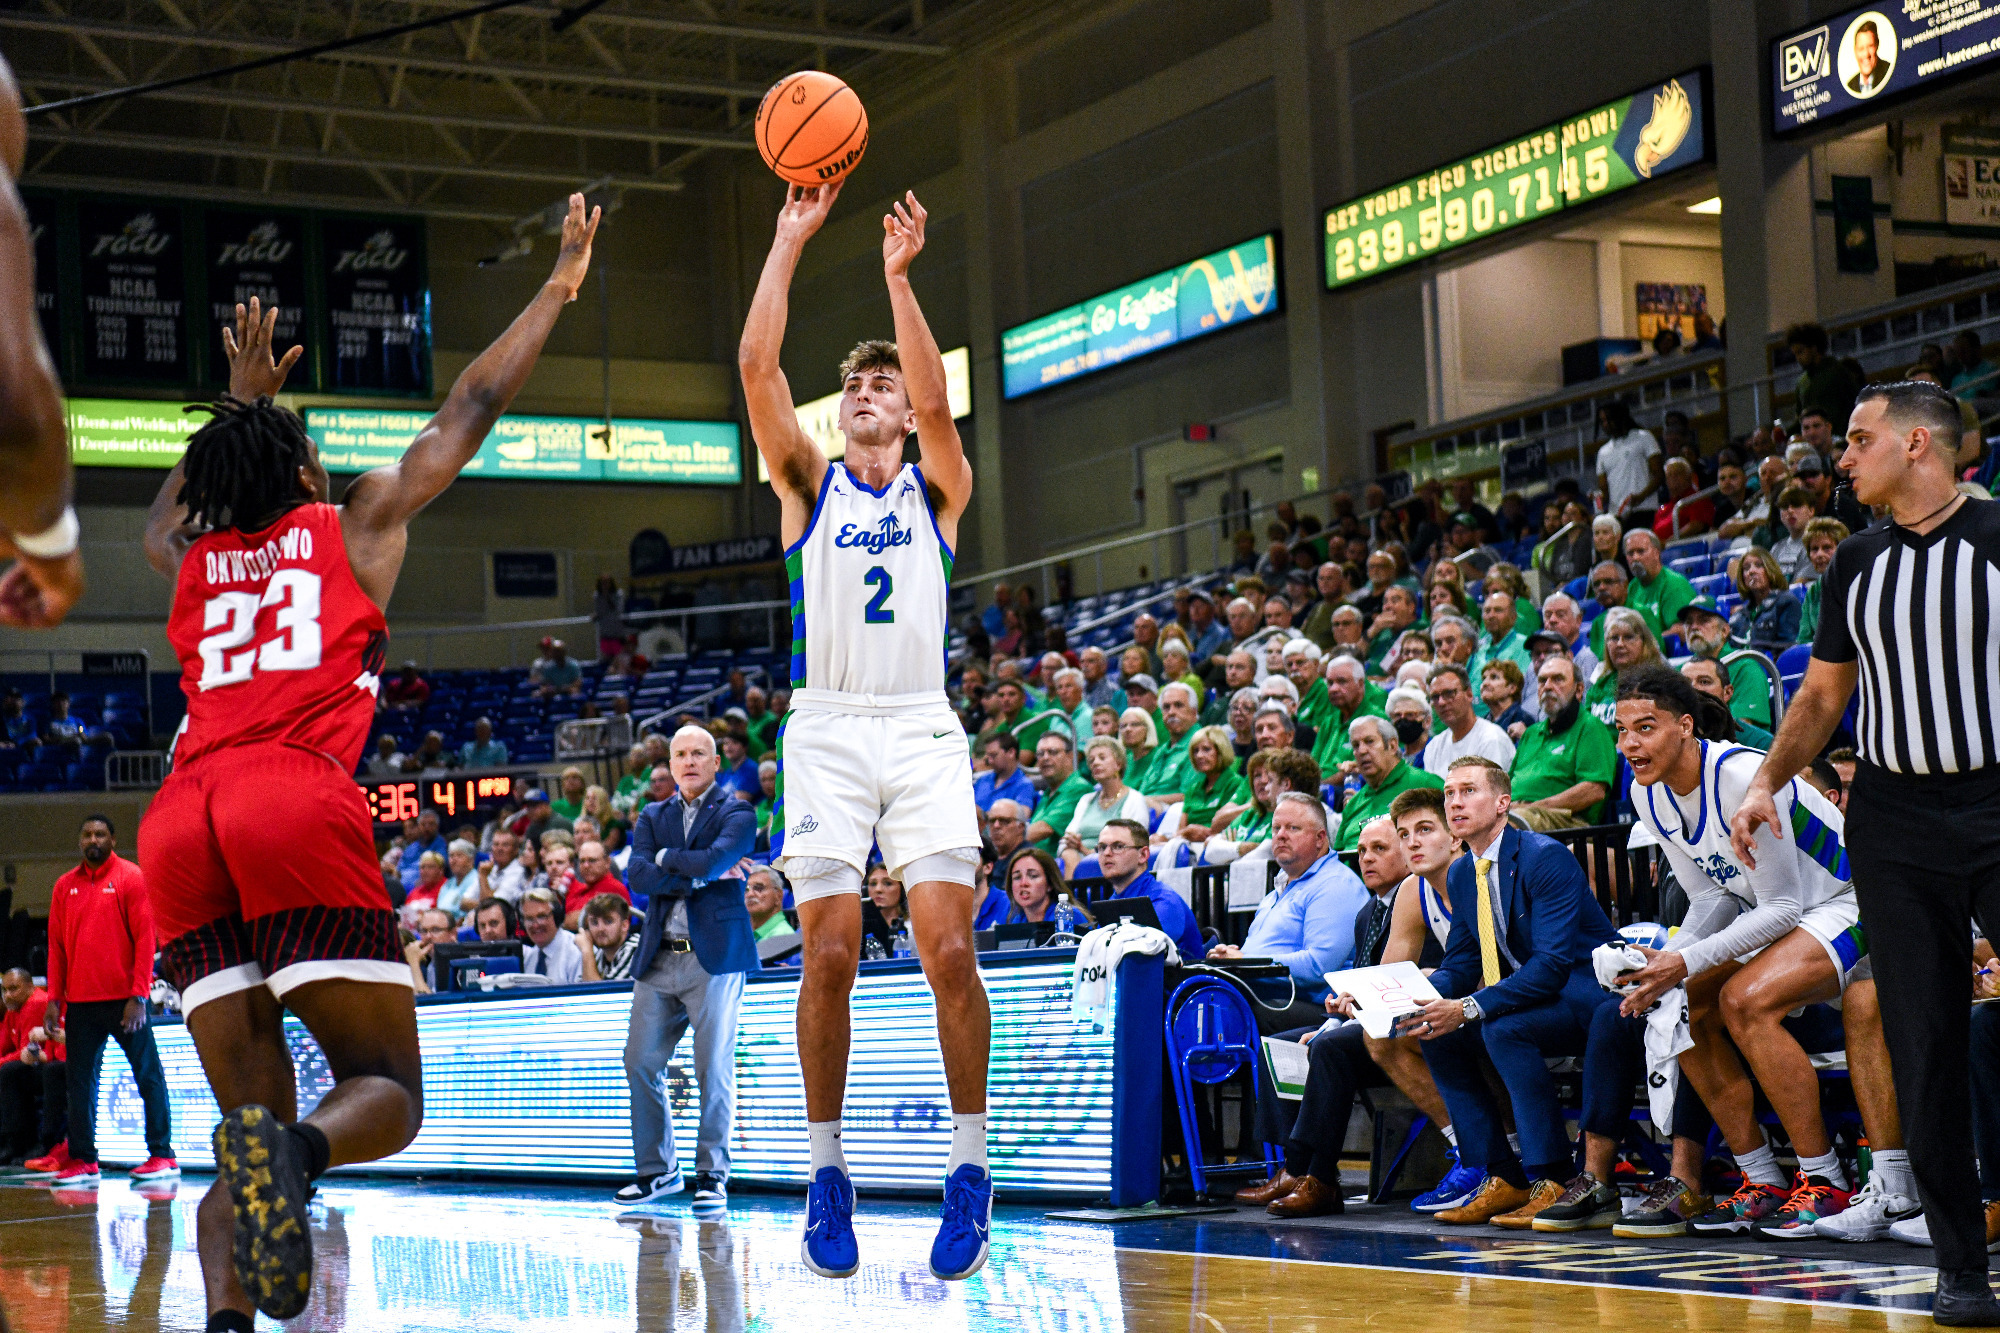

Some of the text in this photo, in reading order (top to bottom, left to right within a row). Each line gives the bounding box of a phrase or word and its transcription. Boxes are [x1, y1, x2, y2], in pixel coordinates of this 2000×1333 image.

[1364, 185, 1412, 218] YOUR
[1471, 131, 1557, 182] TICKETS
[1561, 107, 1619, 148] NOW!
[1334, 145, 1610, 281] 239.590.7145
[1091, 304, 1117, 335] Go
[617, 440, 730, 462] Garden Inn
[672, 538, 771, 568] FAN SHOP
[834, 511, 913, 555] Eagles
[863, 566, 895, 624] 2
[197, 568, 322, 693] 23
[358, 783, 419, 822] :36
[433, 780, 476, 816] 41
